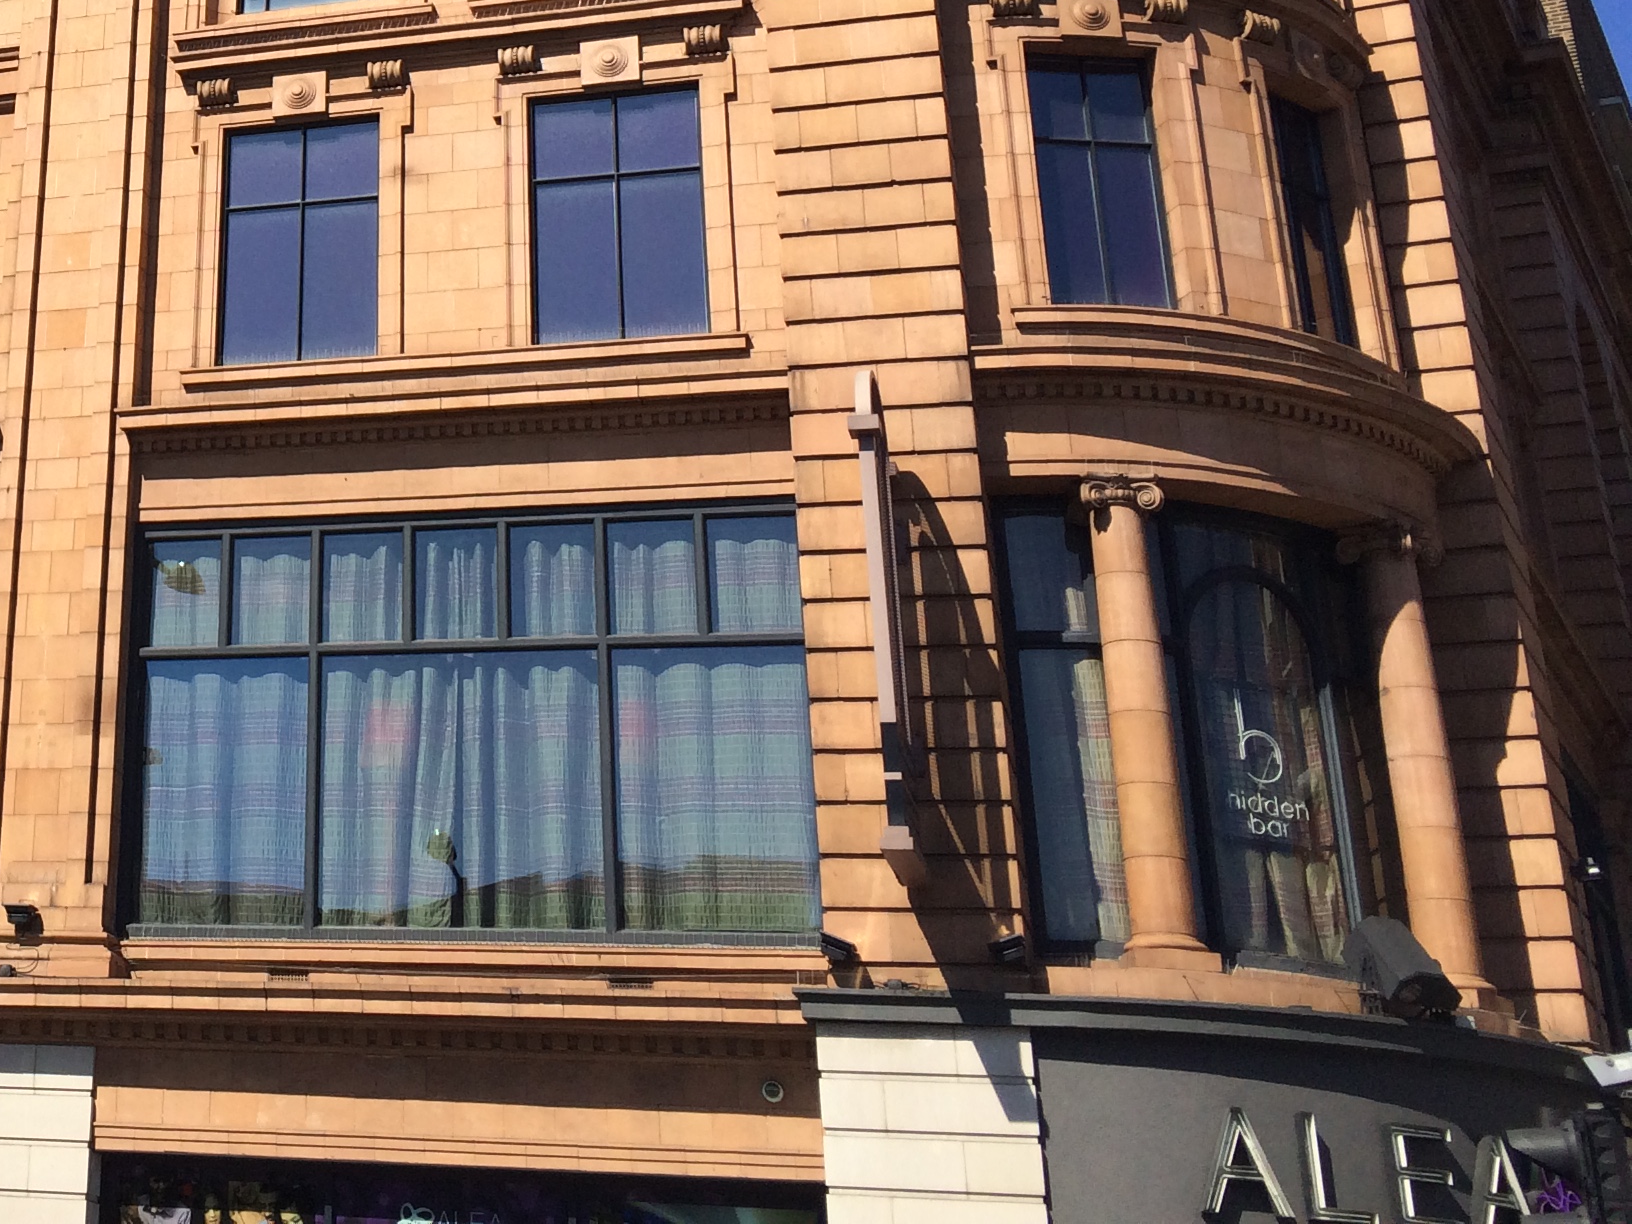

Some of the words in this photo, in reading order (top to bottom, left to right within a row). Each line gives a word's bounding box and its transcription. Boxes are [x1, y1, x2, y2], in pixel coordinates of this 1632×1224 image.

[1229, 790, 1310, 821] hidden
[1248, 813, 1289, 838] bar
[1202, 1107, 1531, 1224] ALEA
